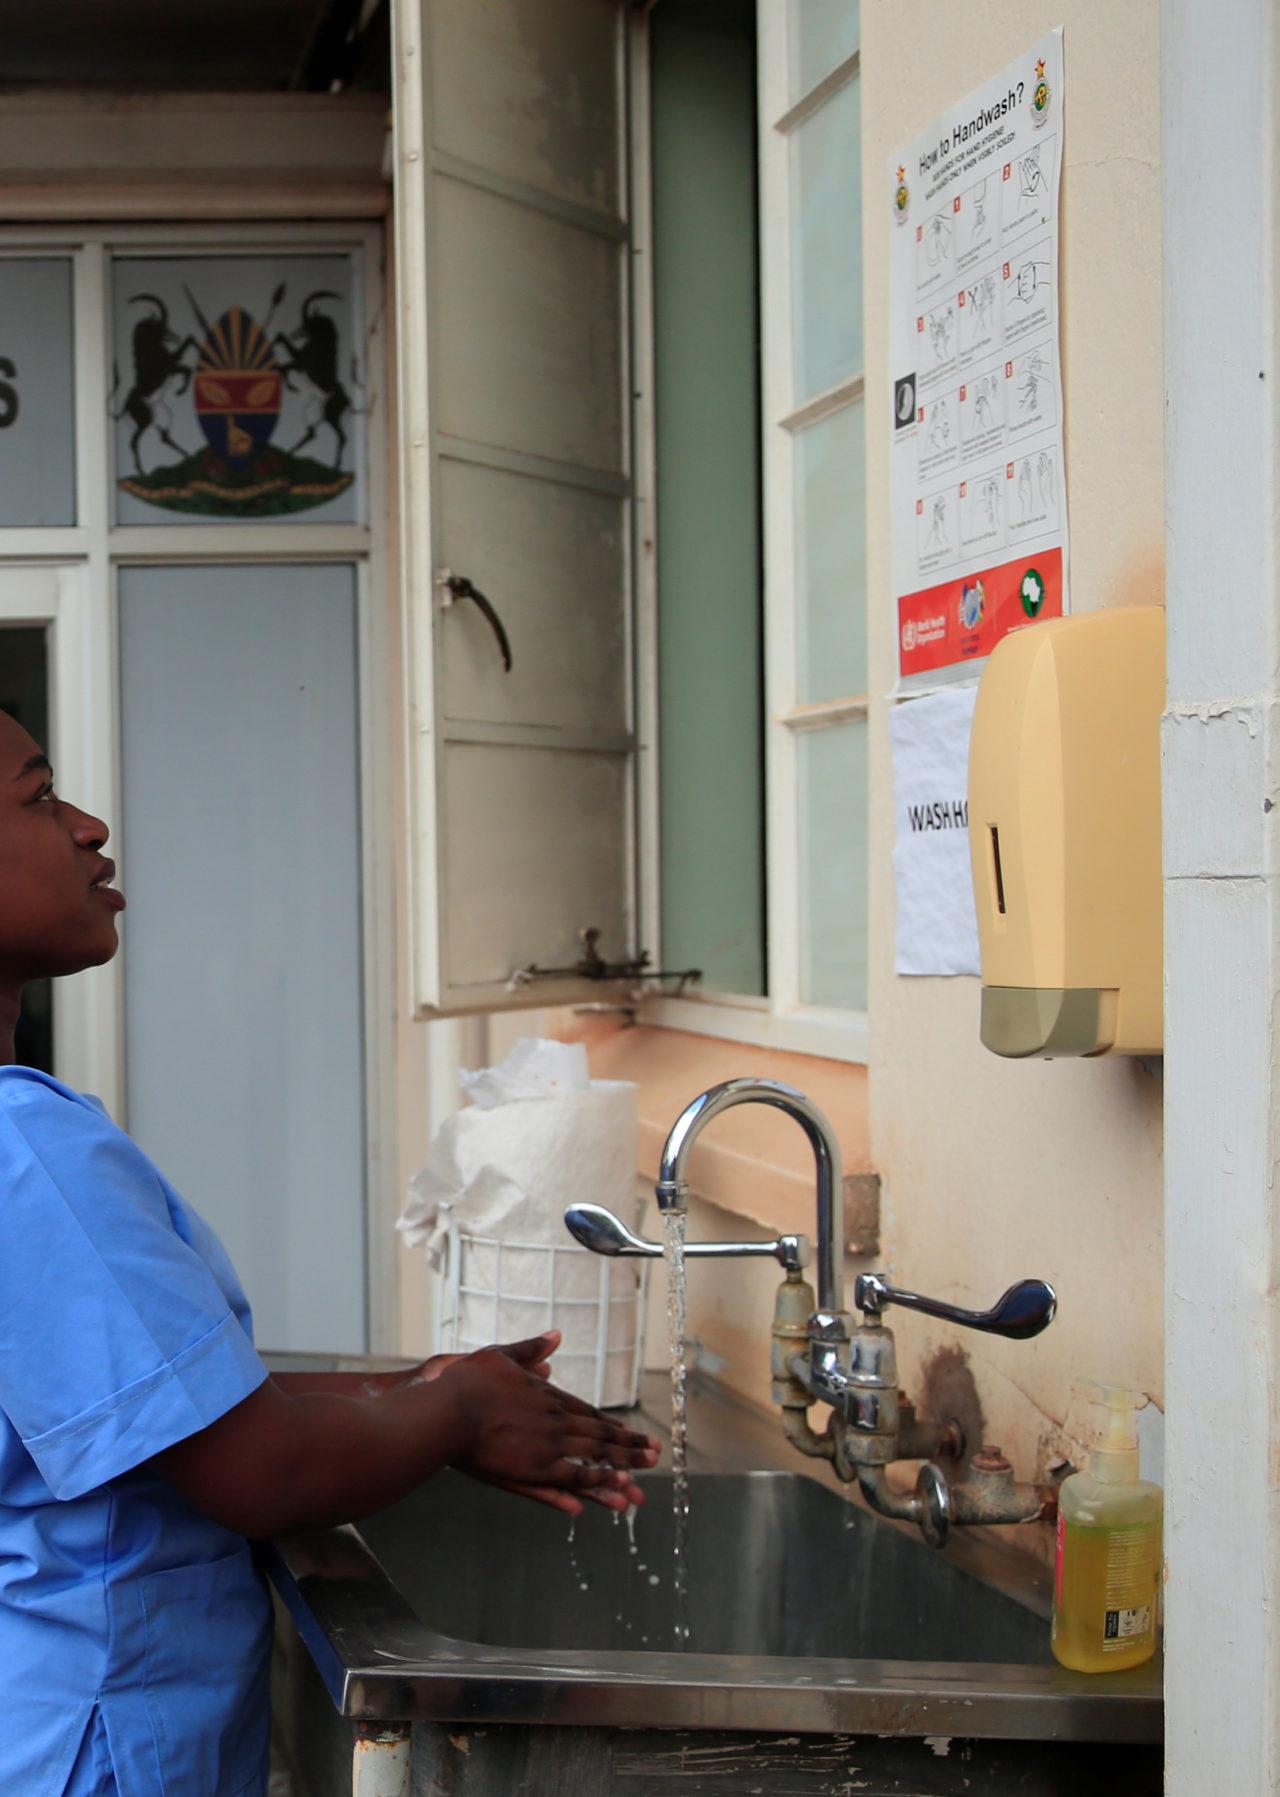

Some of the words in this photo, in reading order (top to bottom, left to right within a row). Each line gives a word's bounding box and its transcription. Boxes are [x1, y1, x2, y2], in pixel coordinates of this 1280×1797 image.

[919, 147, 939, 176] How
[939, 138, 950, 158] to
[952, 82, 1025, 148] Handwash?
[907, 801, 952, 833] WASH
[952, 799, 968, 829] H
